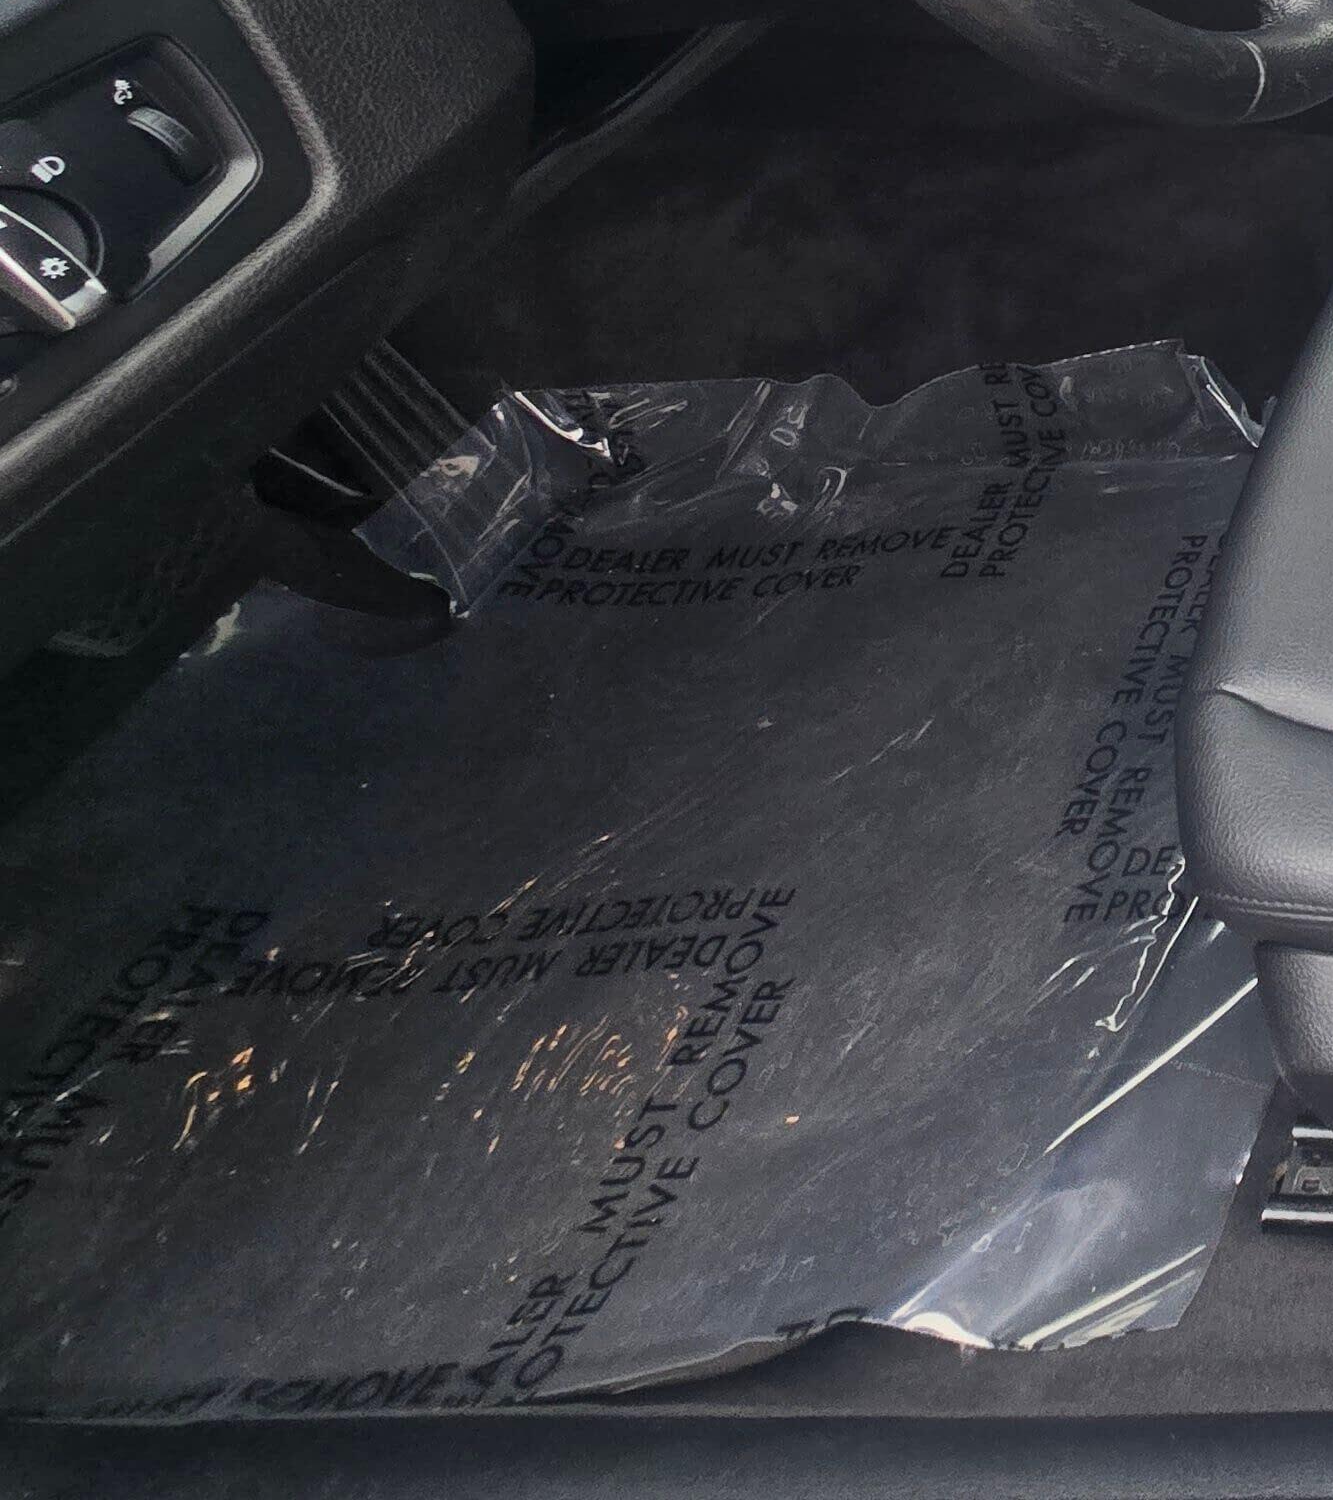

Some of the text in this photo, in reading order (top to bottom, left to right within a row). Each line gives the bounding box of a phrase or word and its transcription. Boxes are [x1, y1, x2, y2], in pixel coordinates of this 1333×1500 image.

[940, 482, 1013, 578] DEALER
[992, 398, 1031, 468] MUST
[978, 428, 1067, 578] PROTECTIVE
[538, 564, 865, 606] PROTECTIVE COVER
[561, 524, 952, 574] DEALER MUST REMOVE
[1054, 534, 1209, 838] PROTECTIVE COVER
[1137, 655, 1192, 744] MUST
[1063, 767, 1152, 924] REMOVE
[432, 950, 561, 994] MUST
[518, 887, 757, 942] PROTECTIVE
[576, 935, 728, 979] DEALER
[578, 1093, 679, 1233] MUST
[668, 887, 797, 1066] REMOVE
[688, 977, 797, 1132] COVER
